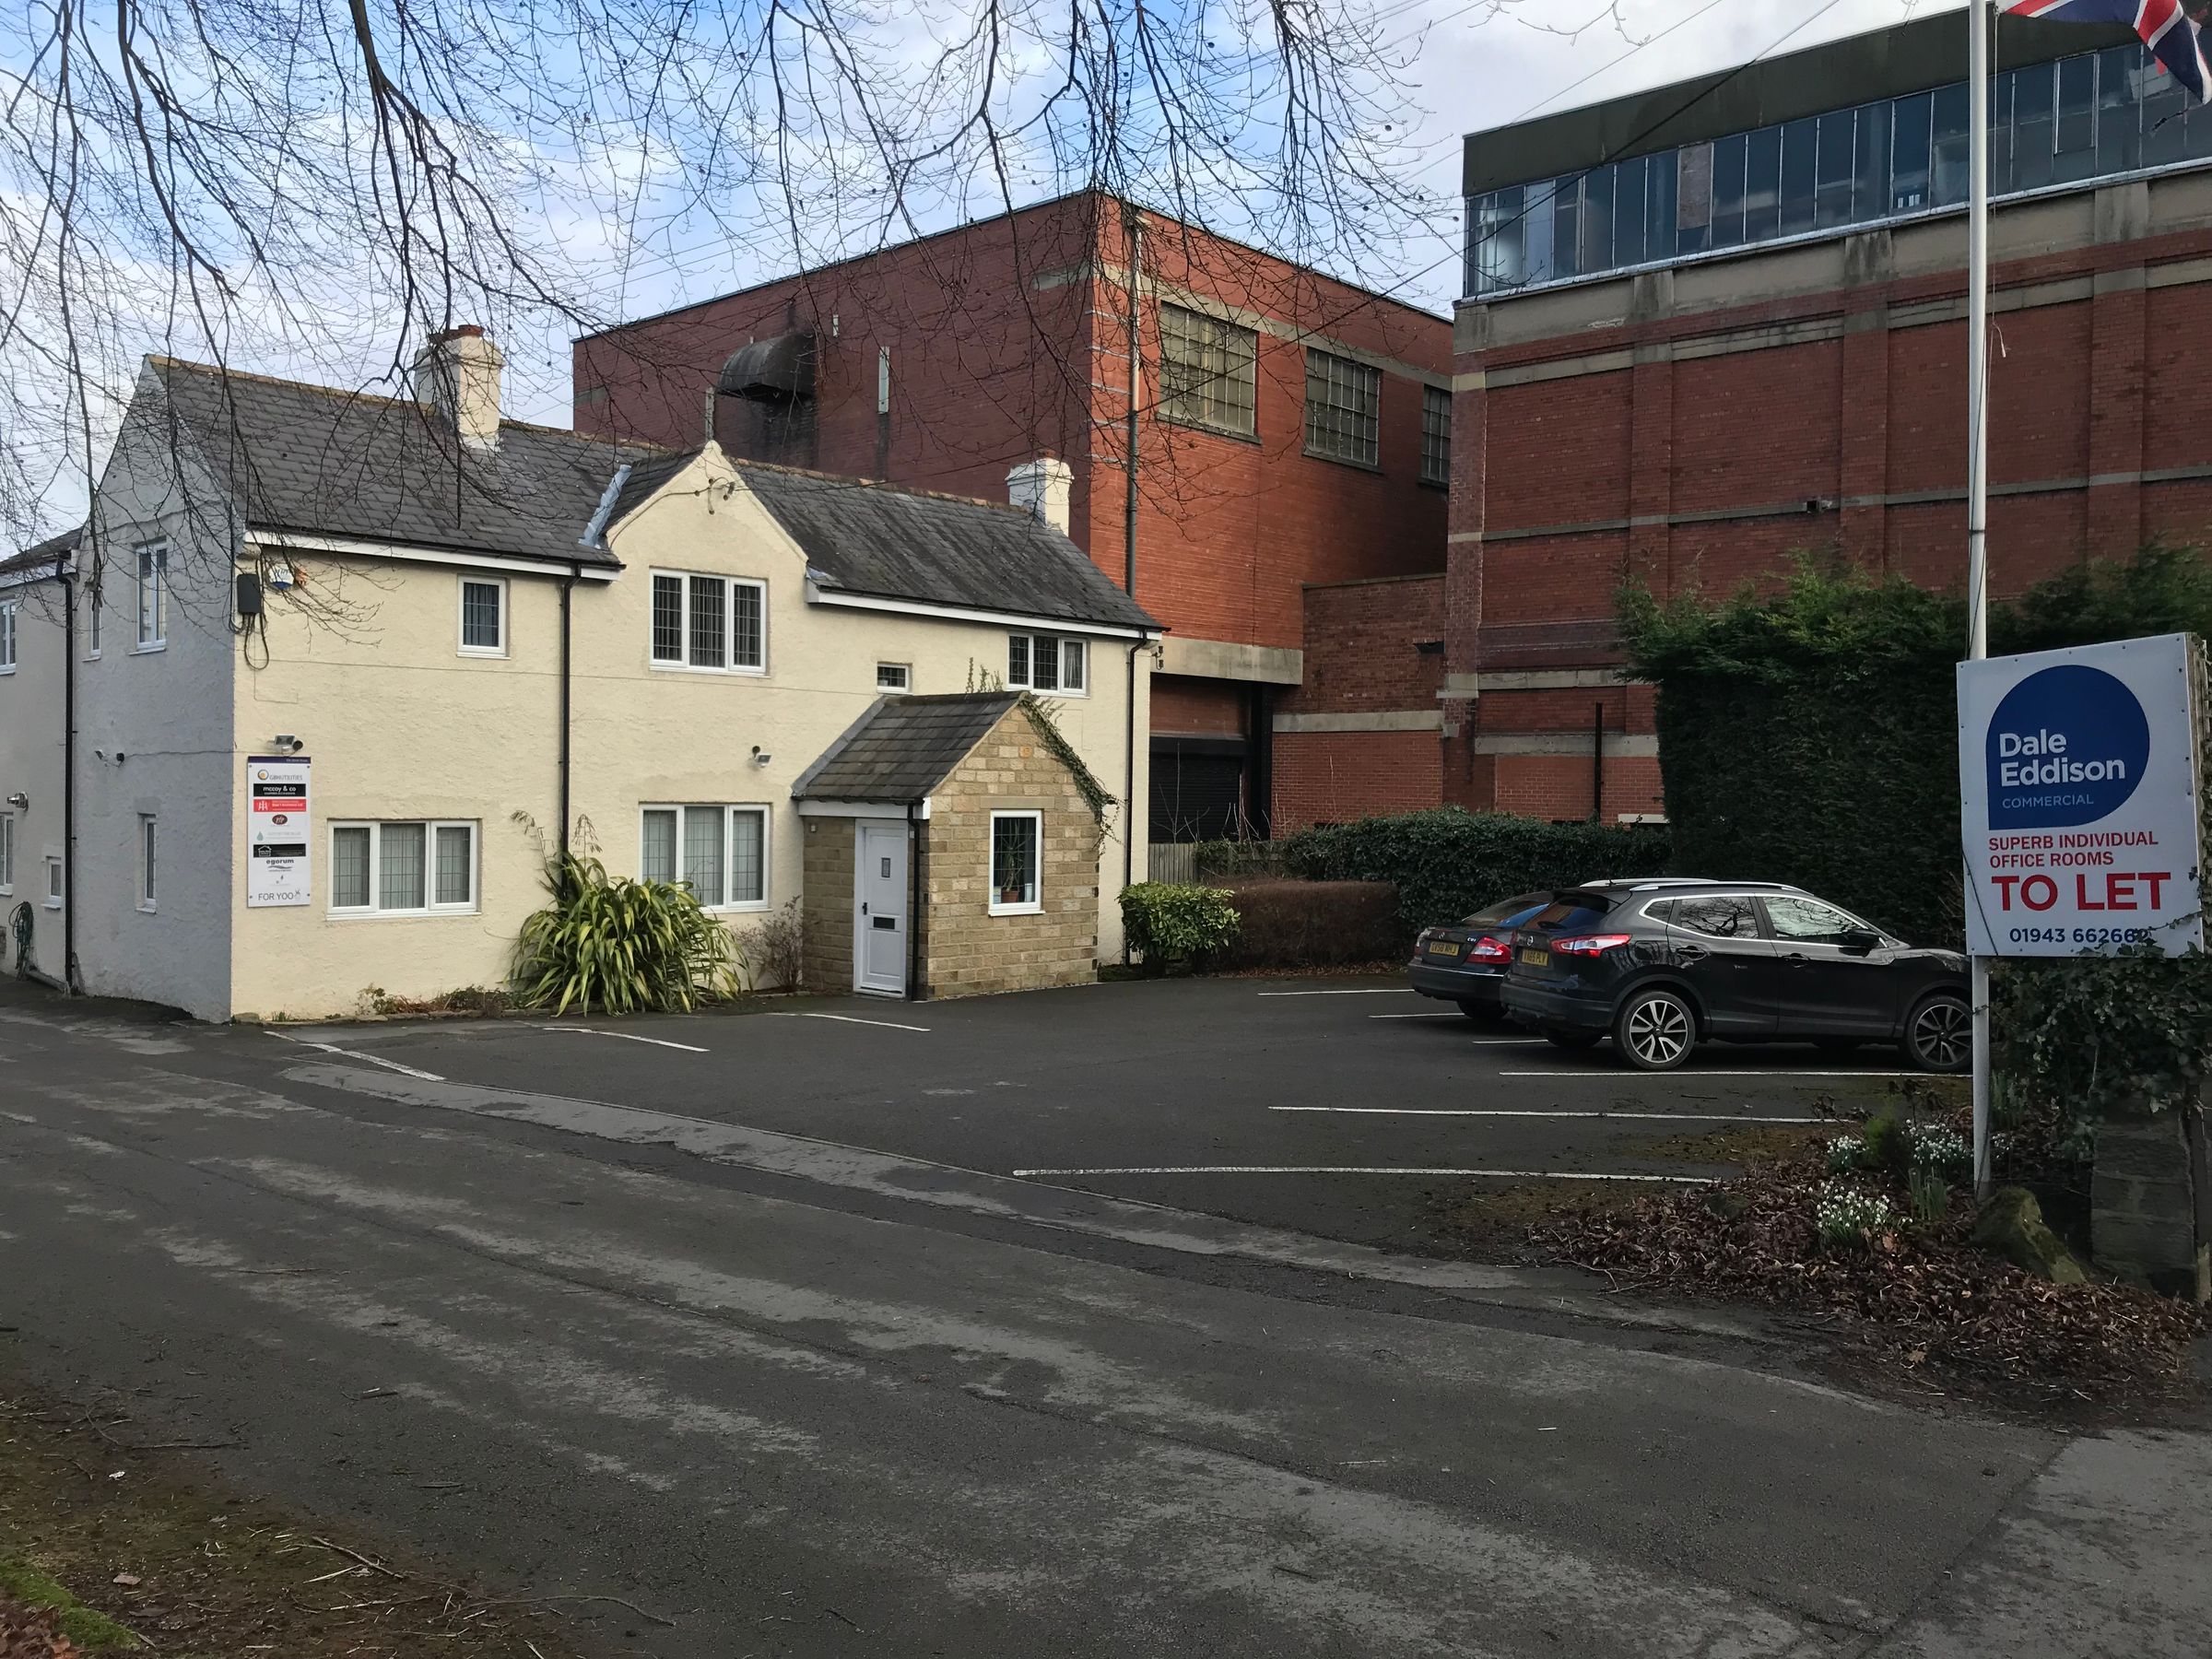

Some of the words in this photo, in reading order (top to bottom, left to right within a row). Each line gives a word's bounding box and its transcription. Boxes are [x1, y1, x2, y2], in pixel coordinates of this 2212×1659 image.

[1999, 729, 2067, 758] Dale
[2000, 757, 2125, 787] Eddison
[2002, 794, 2094, 809] COMMERCIAL
[1989, 835, 2054, 851] SUPERB
[2059, 831, 2159, 848] INDIVIDUAL
[1990, 853, 2045, 868] OFFICE
[2050, 852, 2114, 866] ROOMS
[1991, 874, 2058, 911] TO
[2076, 872, 2171, 911] LET
[2009, 927, 2065, 943] 01943
